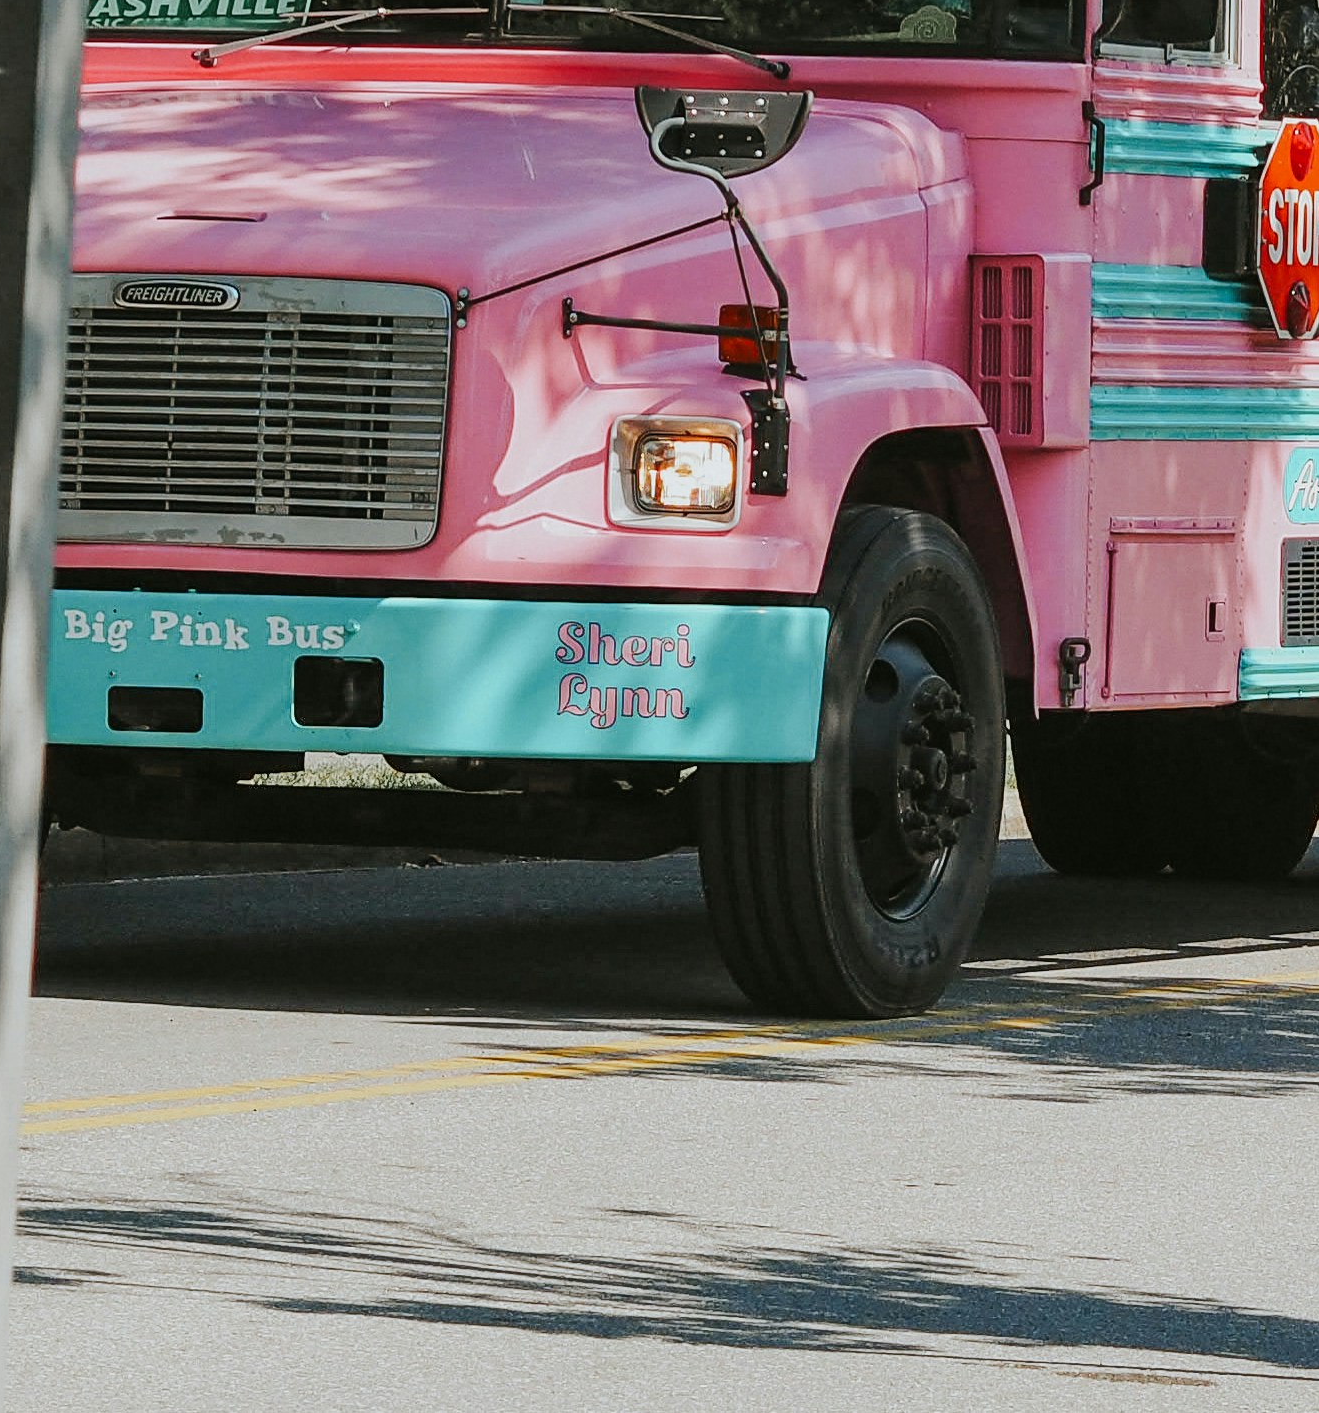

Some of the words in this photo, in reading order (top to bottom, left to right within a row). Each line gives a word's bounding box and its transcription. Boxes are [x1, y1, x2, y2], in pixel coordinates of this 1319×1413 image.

[125, 286, 224, 304] FREIGHTLINER
[63, 608, 133, 653] Big
[149, 610, 250, 650] Pink
[266, 615, 346, 651] Bus
[555, 620, 696, 669] Sheri
[556, 672, 691, 730] Lynn
